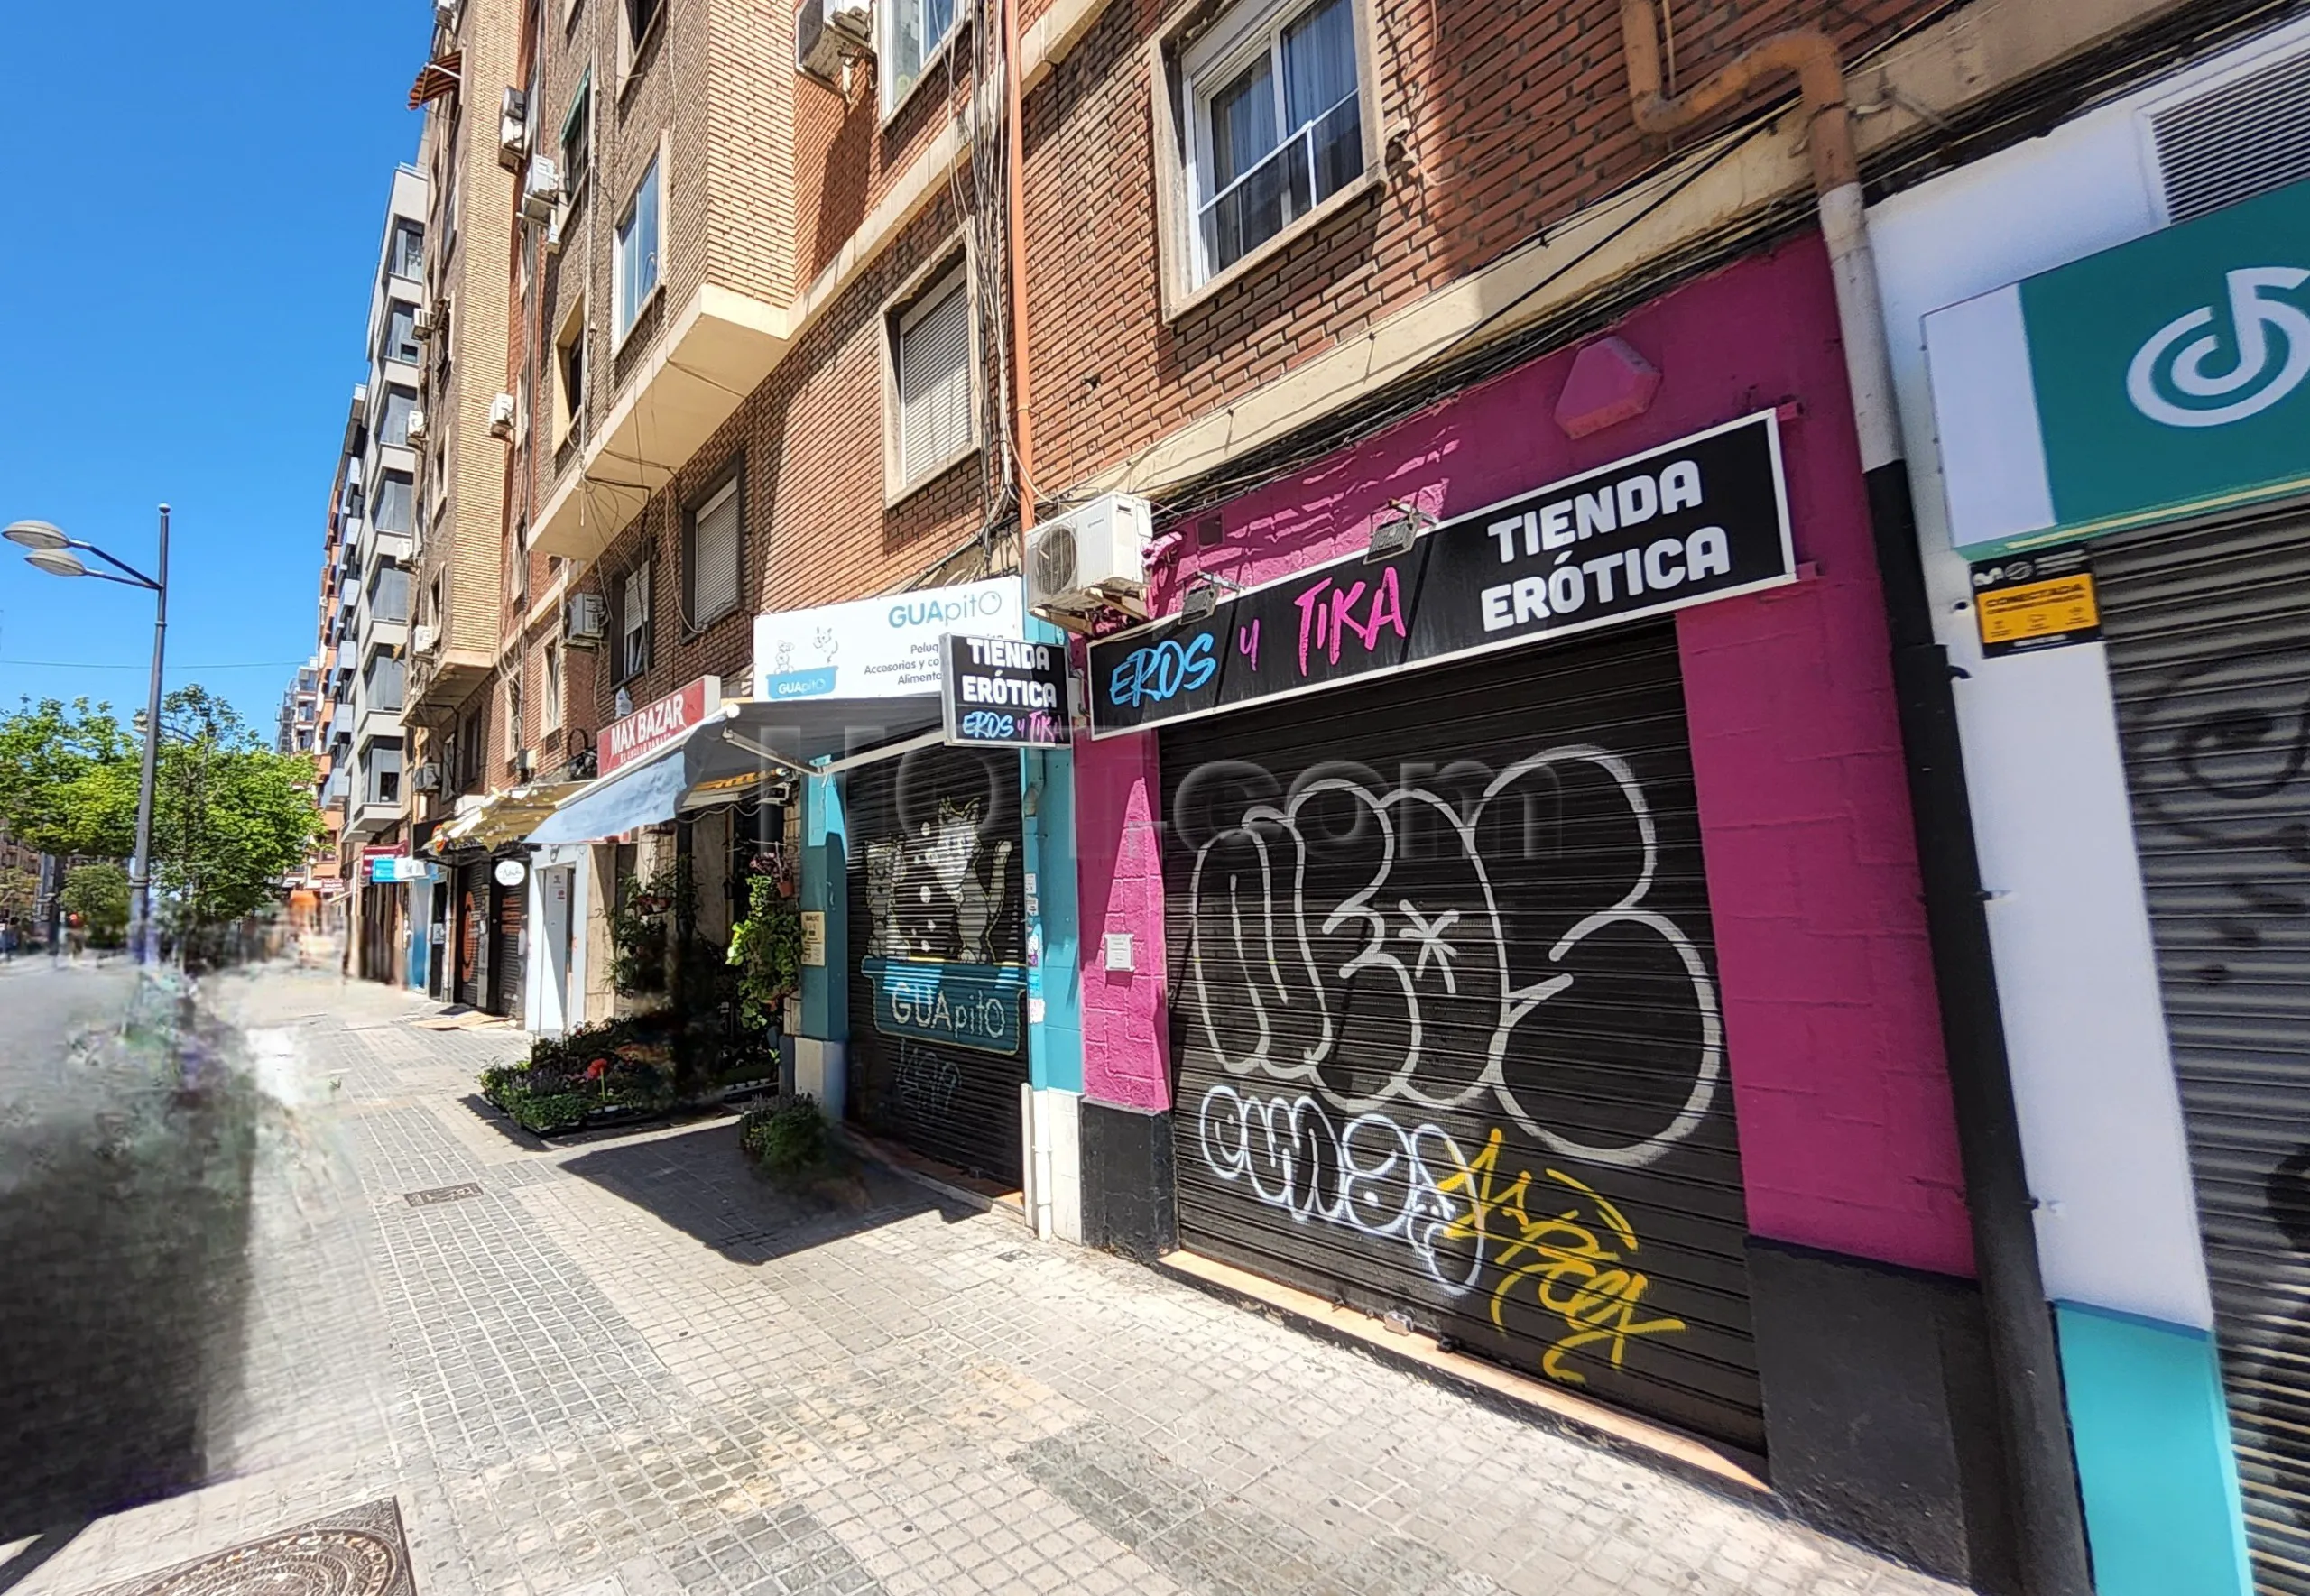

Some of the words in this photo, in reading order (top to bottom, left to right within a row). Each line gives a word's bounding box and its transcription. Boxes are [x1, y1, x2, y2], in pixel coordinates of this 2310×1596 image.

[1487, 460, 1703, 564] TIENDA
[1481, 526, 1731, 632] ERÓTICA
[910, 643, 938, 654] Peluq
[966, 638, 1050, 671] TIENDA
[1109, 632, 1216, 707] EROS
[1294, 567, 1406, 677] TIKA
[864, 660, 917, 675] Accesorios
[919, 660, 926, 670] y
[962, 669, 1057, 708] ERÓTICA
[611, 716, 636, 755] MAX
[637, 693, 686, 743] BAZAR
[962, 711, 1014, 738] EROS
[1029, 710, 1064, 743] TIKA
